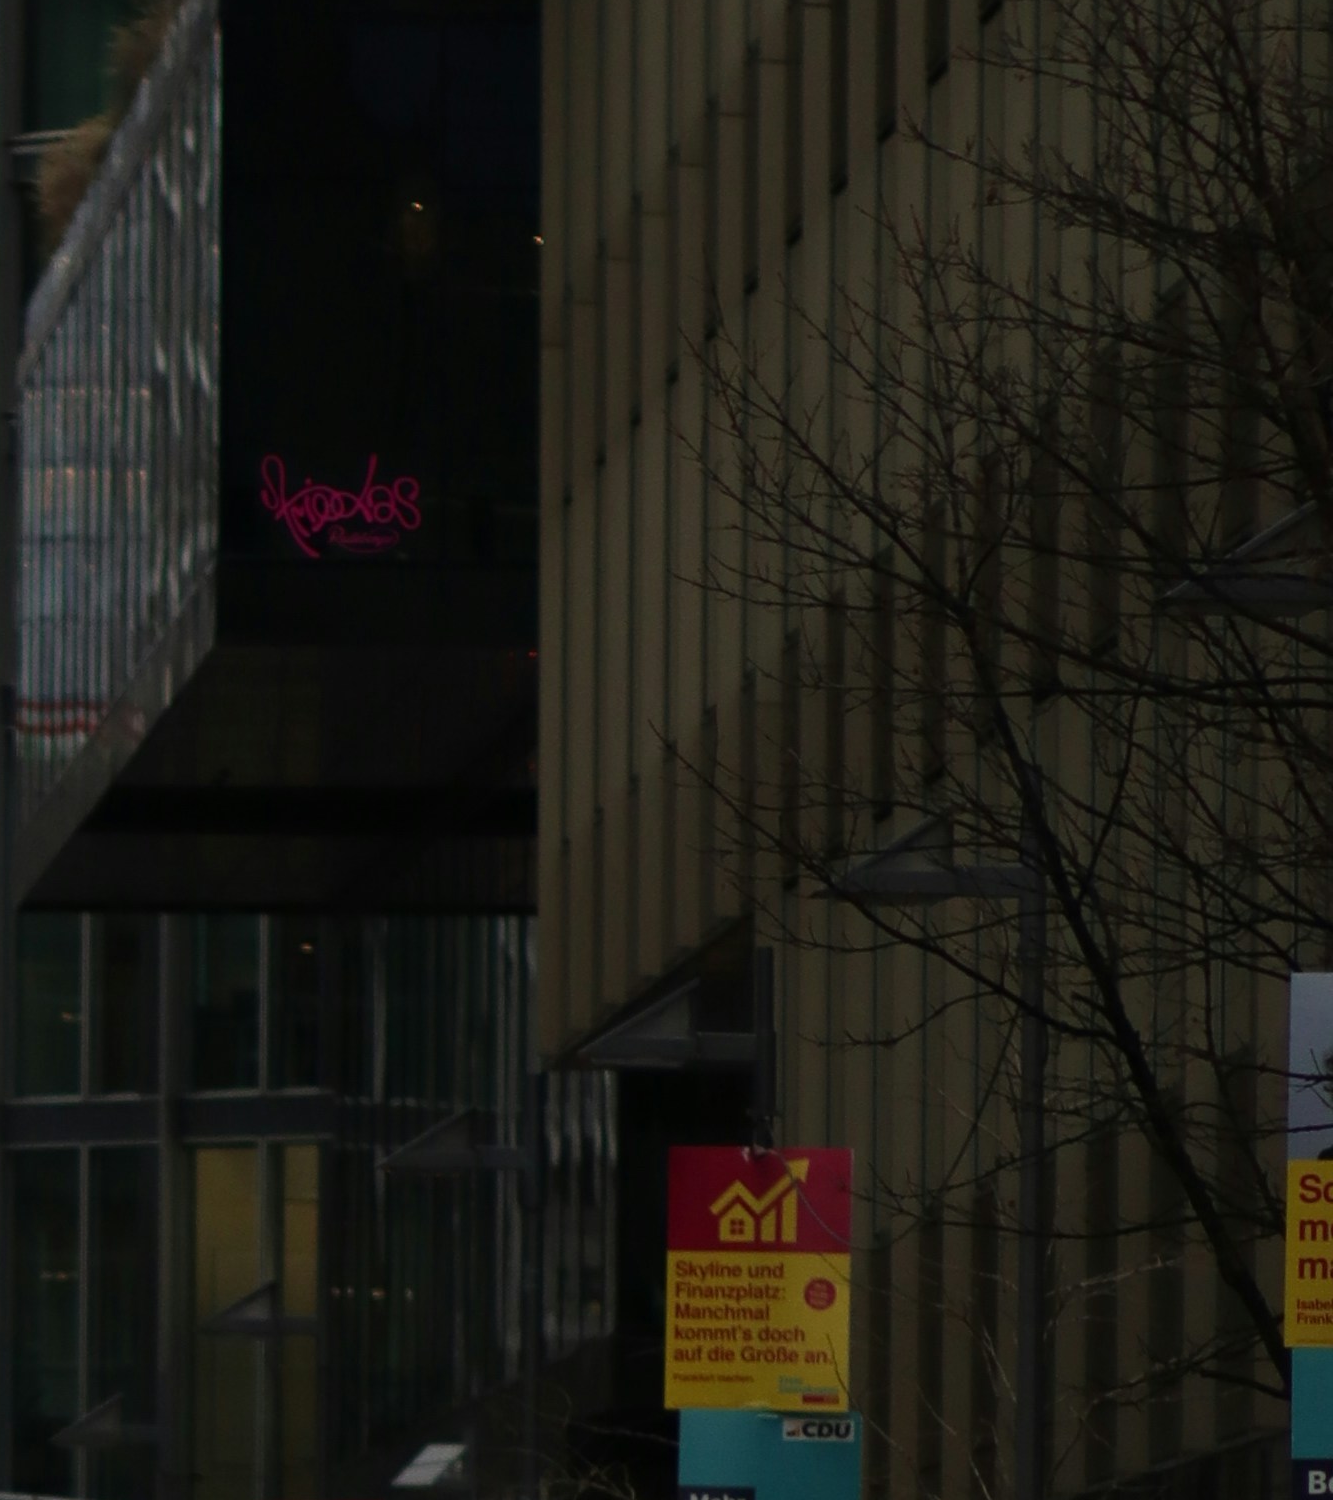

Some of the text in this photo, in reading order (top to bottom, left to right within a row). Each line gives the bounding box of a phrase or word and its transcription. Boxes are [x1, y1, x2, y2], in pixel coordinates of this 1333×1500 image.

[675, 1261, 784, 1280] Skyline und
[675, 1282, 786, 1301] Finanzplatz:
[675, 1303, 769, 1320] Manchmal
[674, 1325, 806, 1341] kommt's doch
[674, 1345, 833, 1364] auf die Größe an.
[803, 1422, 851, 1438] CDU
